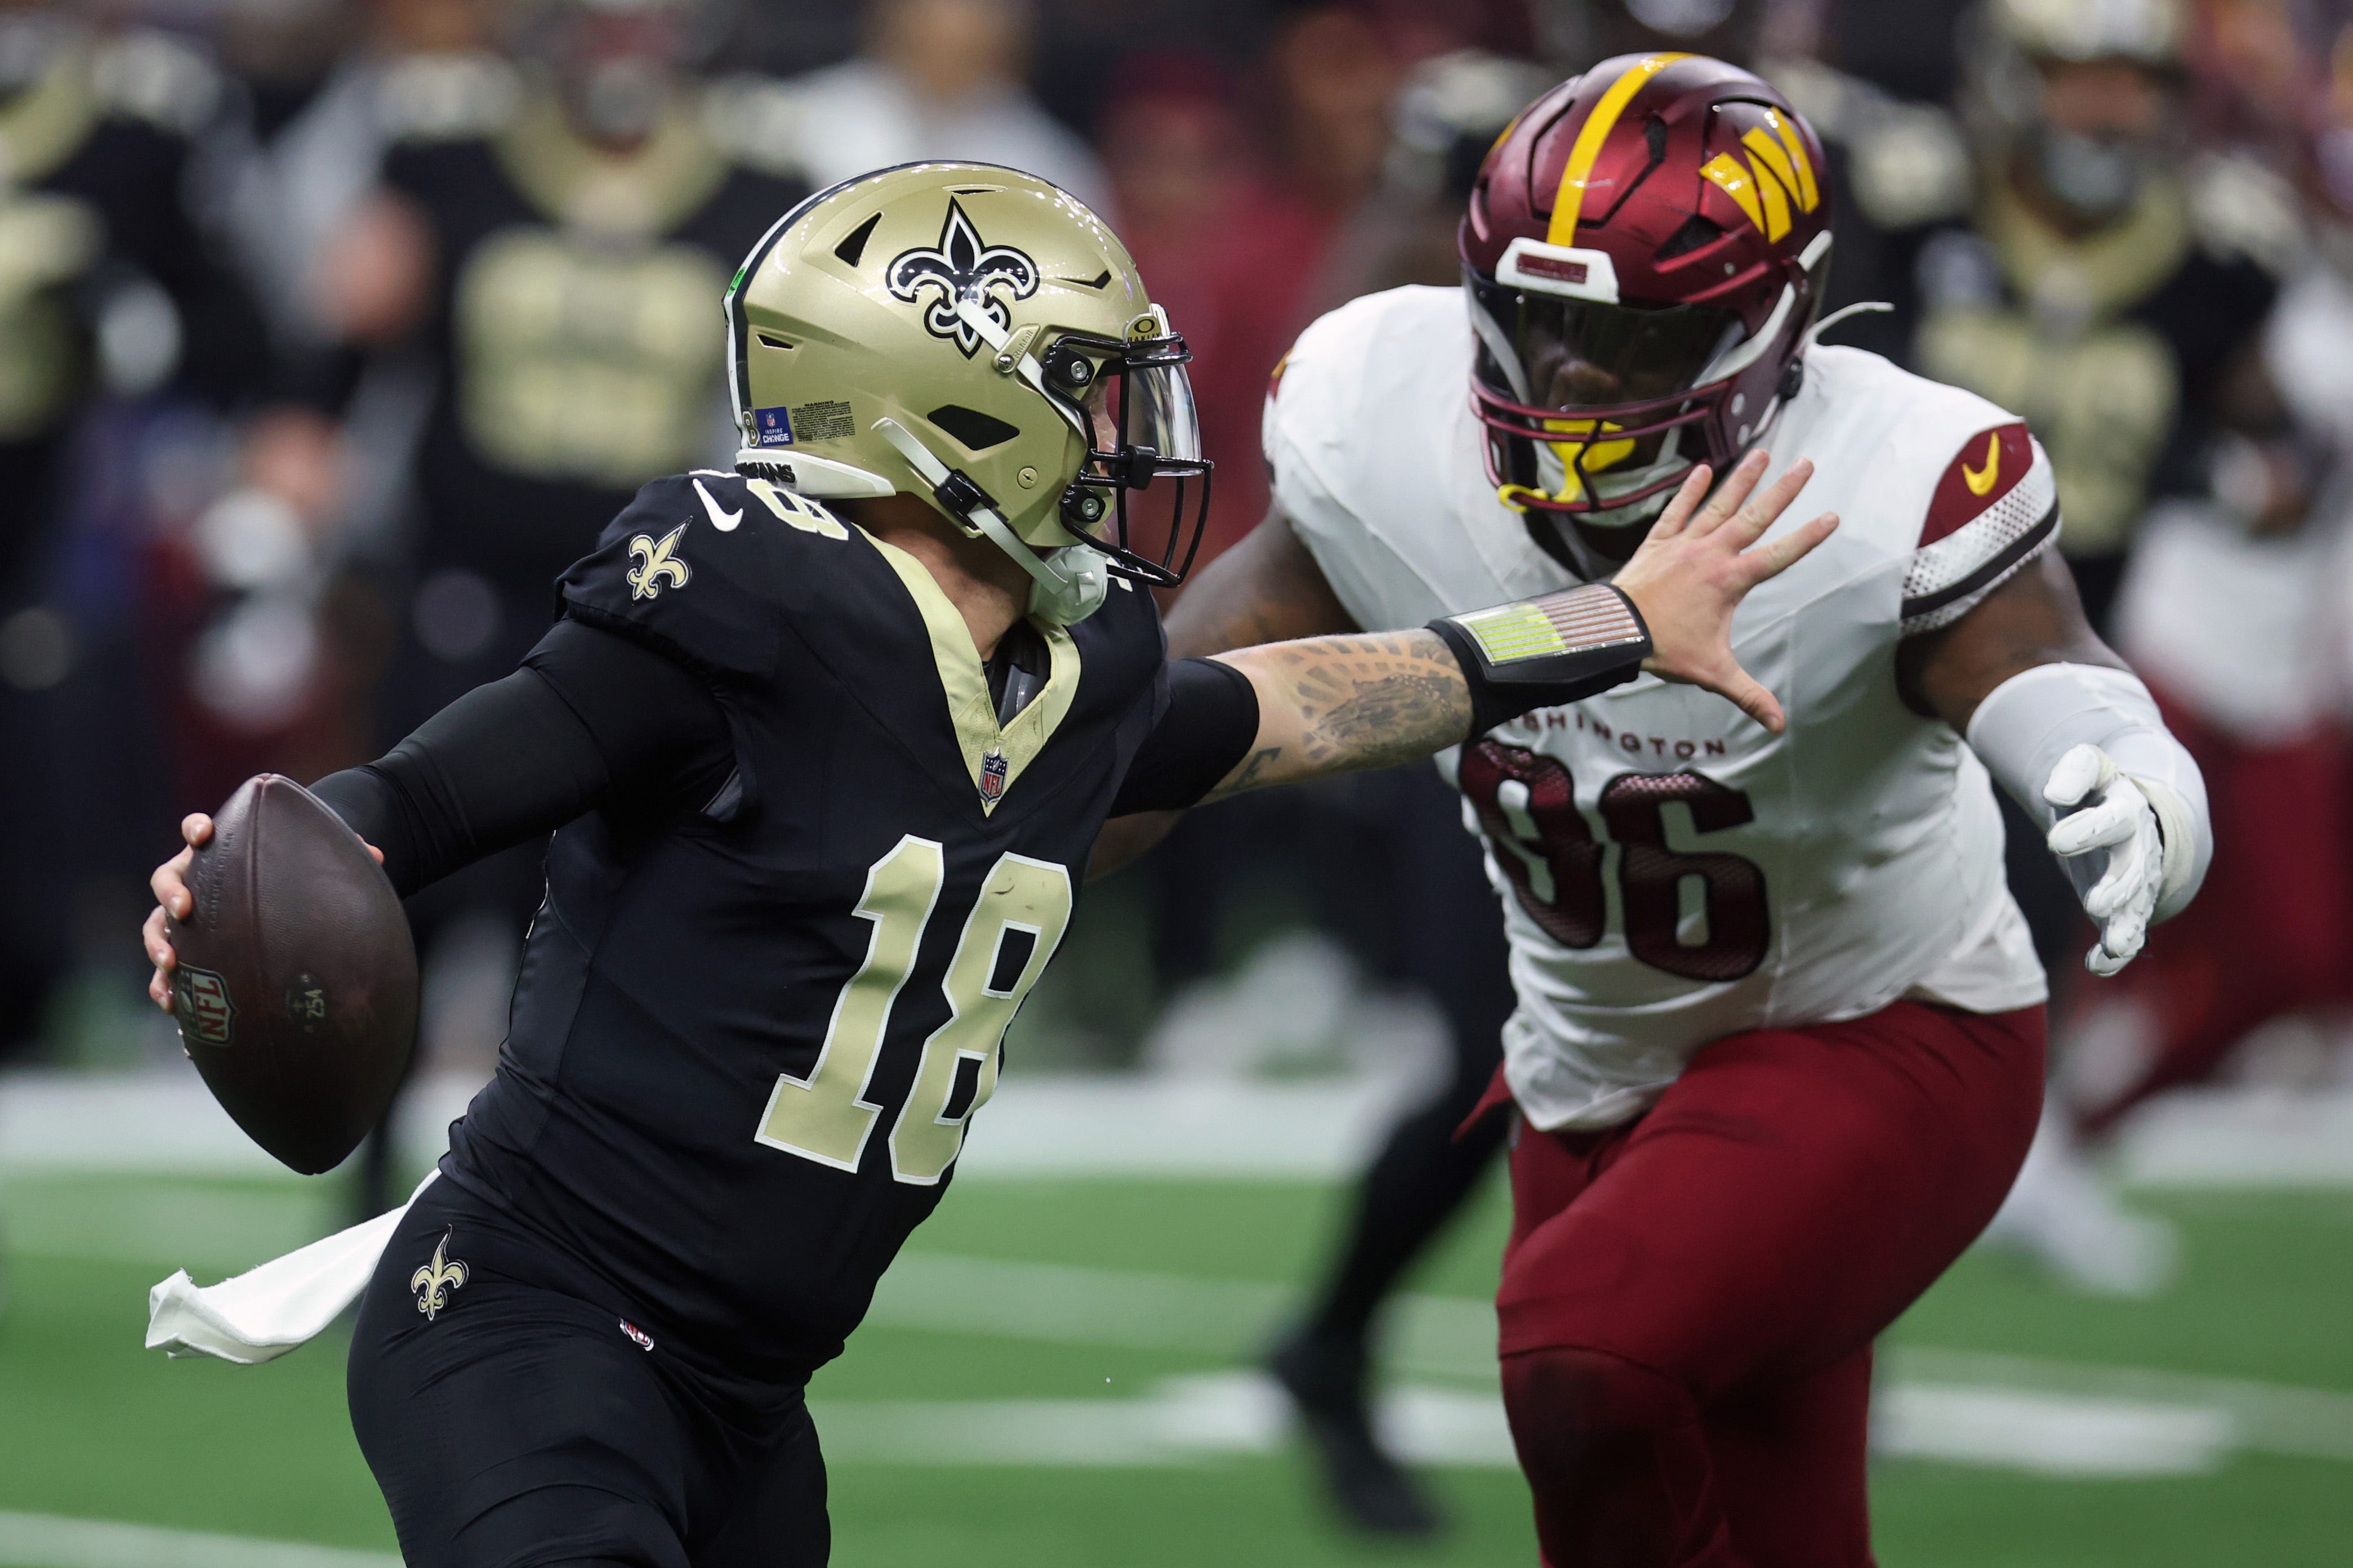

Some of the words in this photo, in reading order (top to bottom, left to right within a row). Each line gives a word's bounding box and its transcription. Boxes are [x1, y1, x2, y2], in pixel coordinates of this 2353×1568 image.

[763, 433, 790, 444] CHANGE
[983, 772, 1001, 796] NFL
[1458, 736, 1771, 982] 96
[194, 979, 227, 1038] NFL
[755, 833, 1073, 1186] 18
